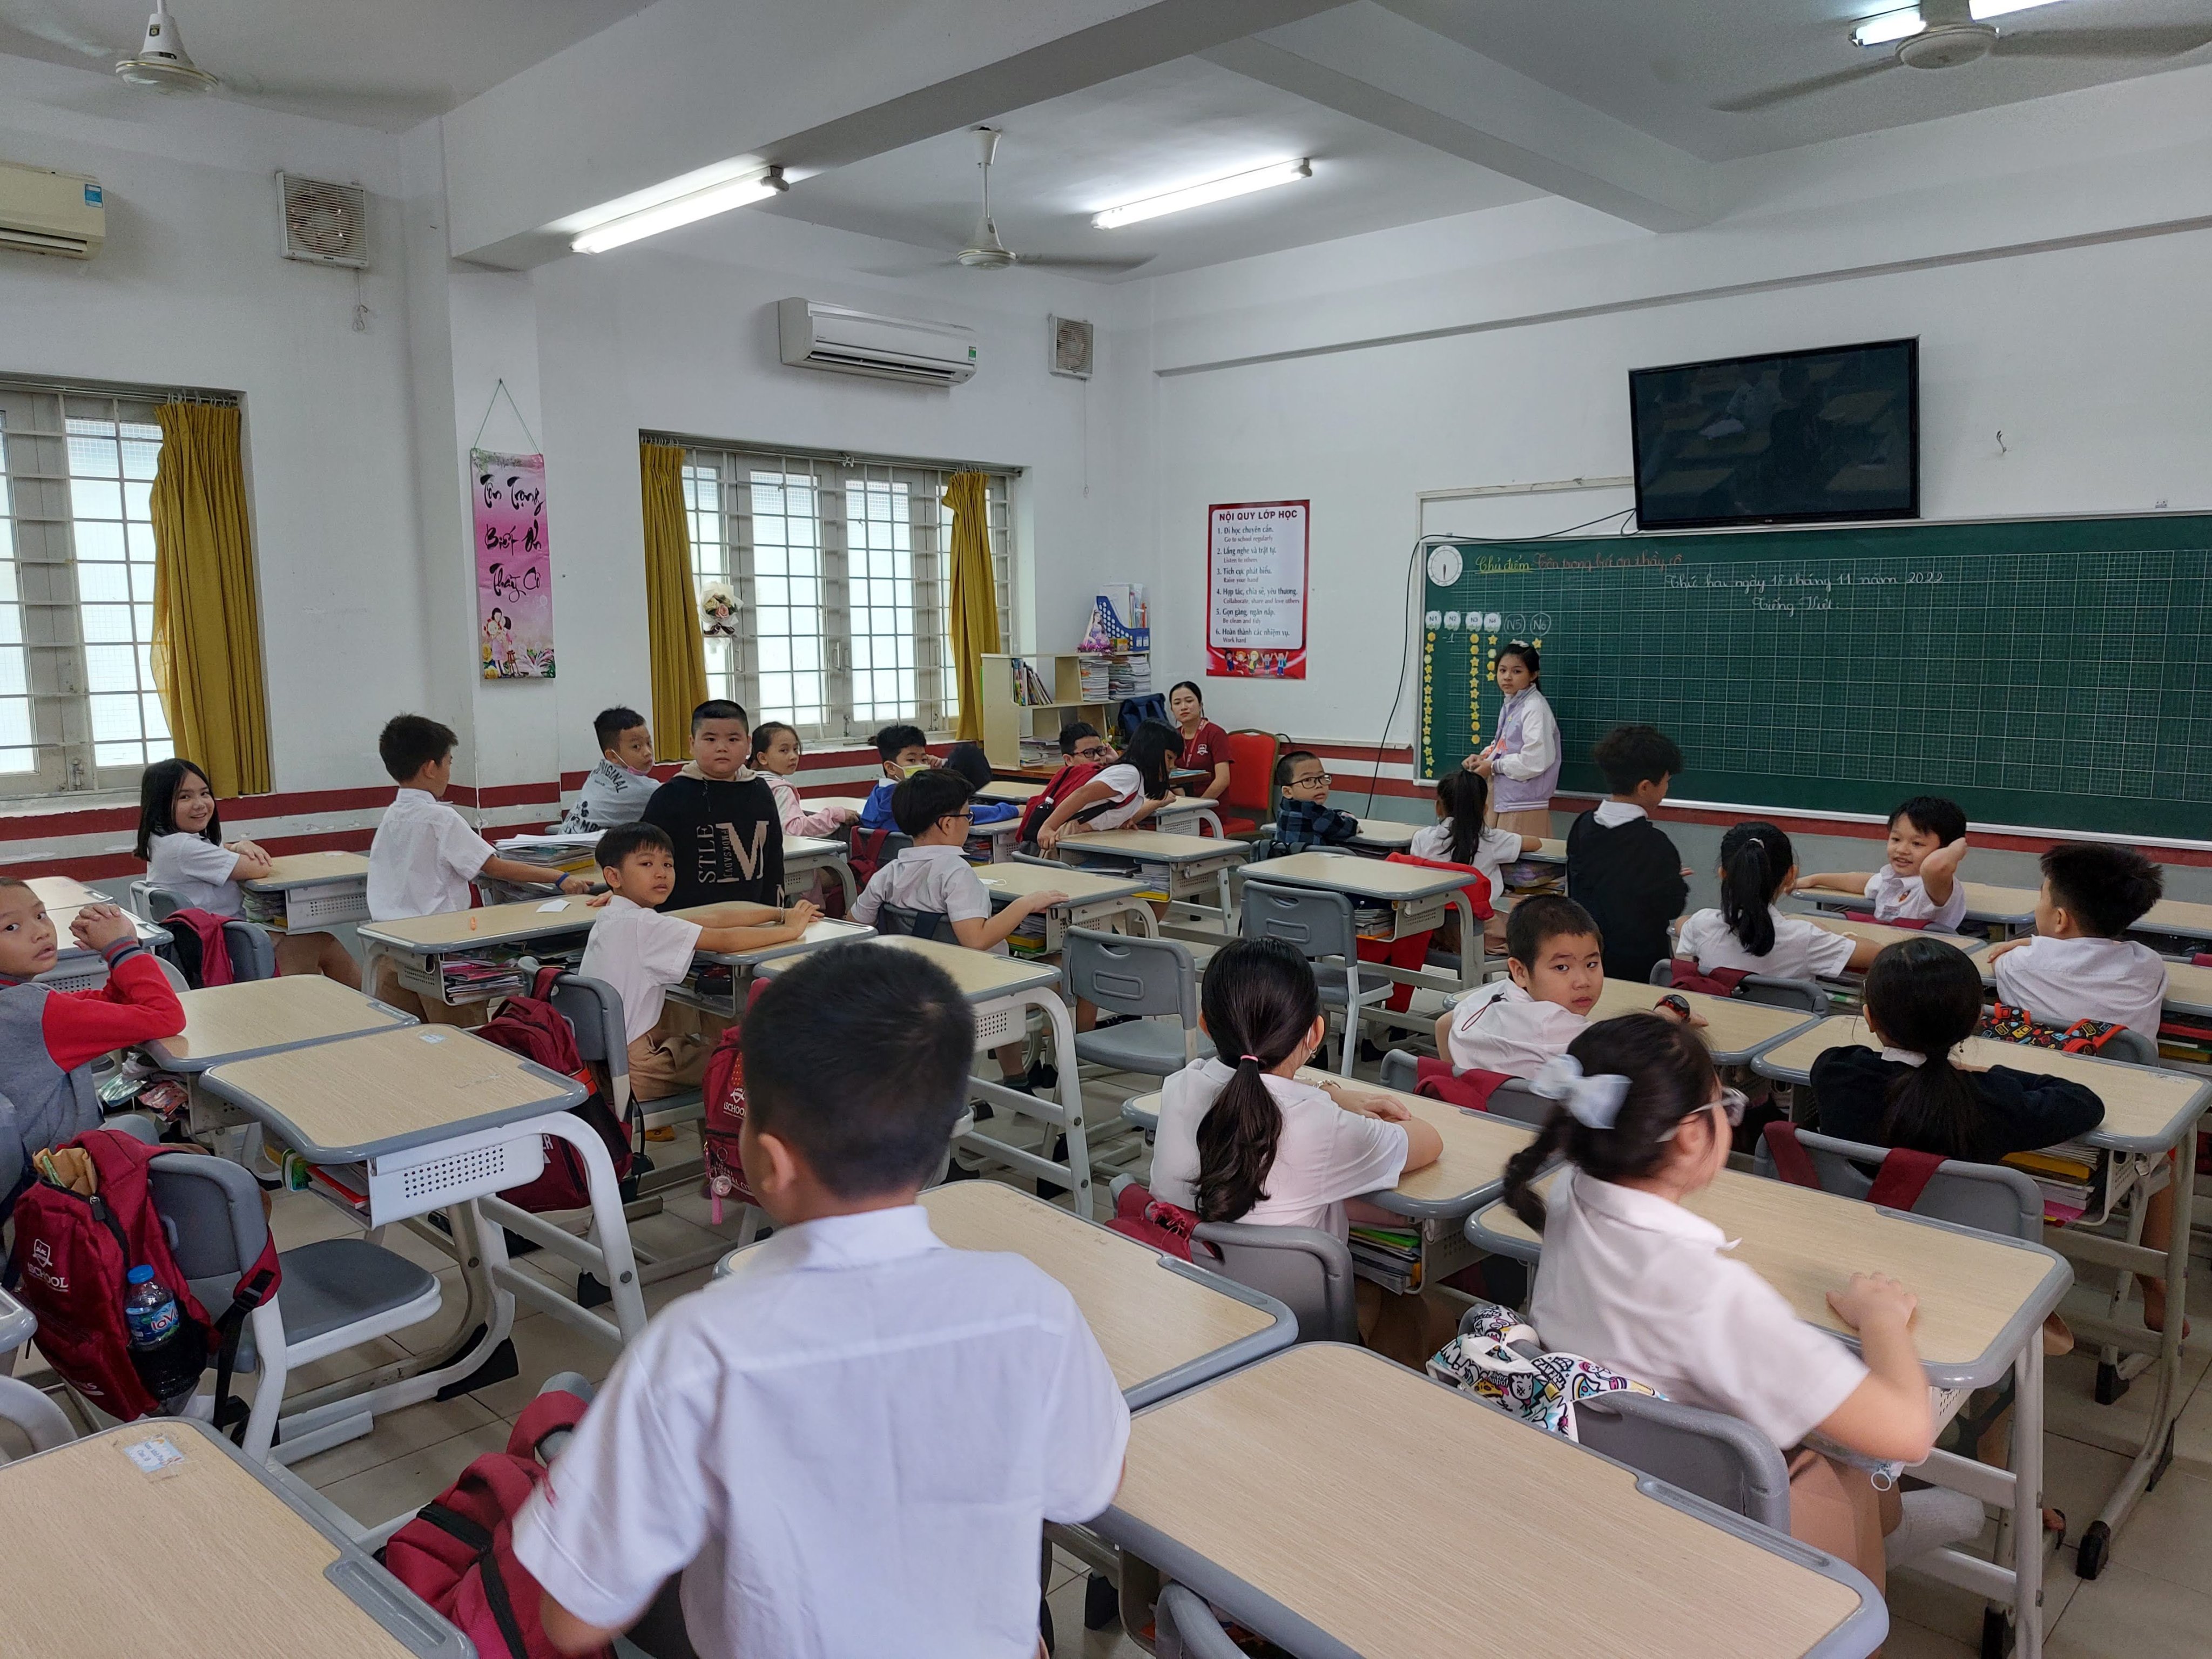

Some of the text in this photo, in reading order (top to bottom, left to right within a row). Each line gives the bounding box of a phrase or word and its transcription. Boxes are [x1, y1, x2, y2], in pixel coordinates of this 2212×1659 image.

[507, 476, 544, 516] Trọng
[1219, 510, 1298, 522] NỘI QUY LỚP HỌC
[1232, 527, 1240, 535] học
[1243, 526, 1260, 535] chuyên
[1237, 547, 1249, 556] nghe
[1246, 567, 1258, 576] phát
[1735, 575, 1765, 594] ngày
[1789, 573, 1831, 592] tháng
[1836, 573, 1851, 584] 11
[1858, 572, 1897, 584] năm
[1906, 571, 1943, 584] 2022
[1223, 588, 1233, 597] Hợp
[1223, 608, 1233, 616] Gọn
[1507, 618, 1522, 631] N5
[1533, 618, 1547, 631] N6
[1222, 628, 1236, 636] Hoàn
[1237, 628, 1252, 636] thành
[1253, 628, 1263, 636] các
[697, 824, 717, 884] STLE
